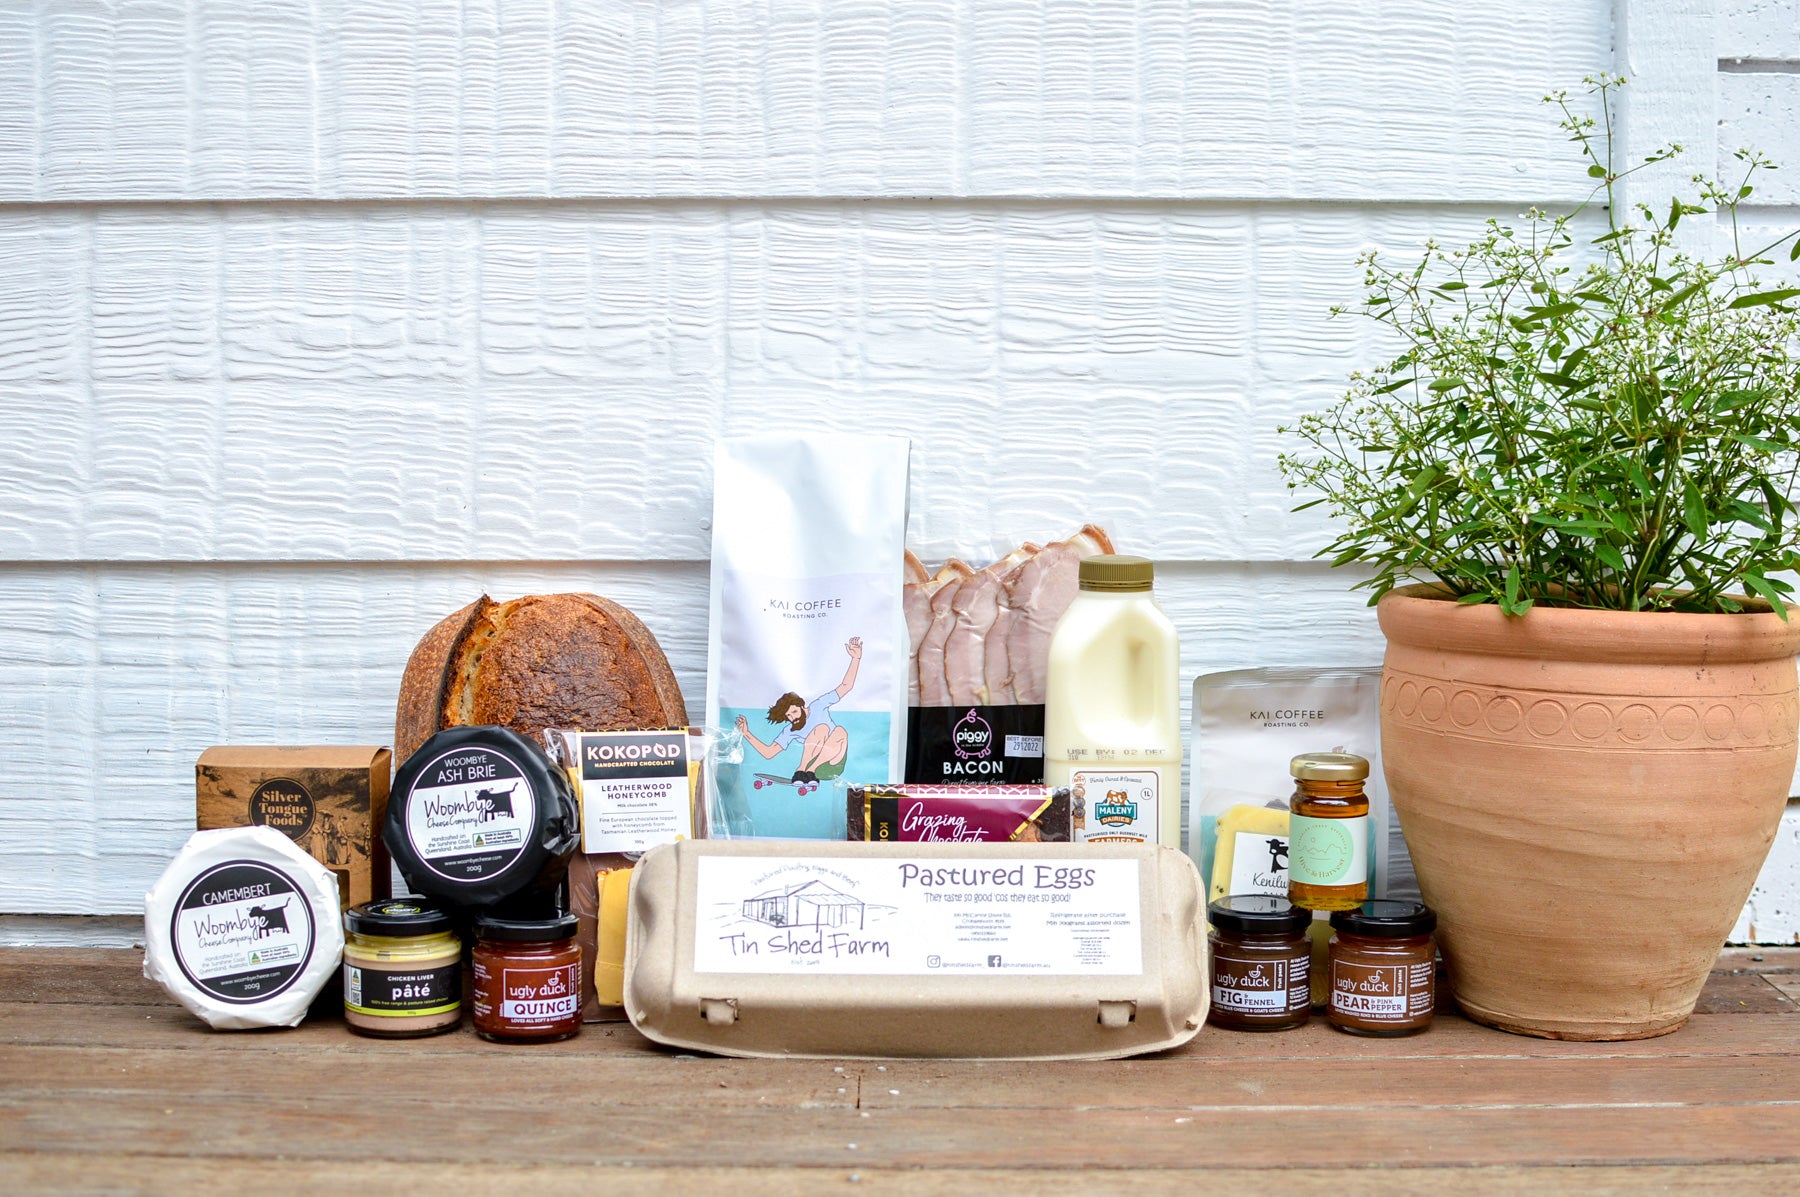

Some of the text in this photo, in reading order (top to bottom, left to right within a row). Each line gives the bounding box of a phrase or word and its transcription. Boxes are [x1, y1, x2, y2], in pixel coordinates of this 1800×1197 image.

[770, 599, 841, 611] KAI COFFEE
[1250, 710, 1324, 719] KAI COFFEE
[957, 728, 989, 743] piggy
[587, 743, 680, 760] KOKOPOD
[445, 755, 487, 767] WOOMBYE
[943, 761, 1003, 774] BACON
[437, 764, 496, 783] ASH BRIE
[601, 783, 672, 792] LEATHERWOOD
[262, 790, 302, 802] Silver
[259, 803, 308, 817] Tongue
[424, 790, 495, 823] Woombye
[265, 814, 304, 826] Foods
[902, 802, 967, 837] Grazing
[898, 864, 1096, 890] Pastured Eggs
[202, 883, 271, 905] CAMEMBERT
[924, 892, 942, 903] They
[944, 894, 962, 902] taste
[964, 894, 972, 902] so
[974, 892, 992, 903] good
[1010, 893, 1026, 903] they
[1027, 894, 1040, 902] eat
[1041, 894, 1050, 902] so
[1051, 893, 1071, 903] good!
[194, 908, 269, 941] Woombye
[719, 930, 890, 957] Tin Shed Farm
[1216, 974, 1270, 987] ugly duck
[1337, 978, 1389, 992] ugly duck
[392, 983, 430, 1000] pâté
[509, 982, 566, 999] ugly duck
[1220, 990, 1242, 1003] FIG
[514, 999, 572, 1015] QUINCE
[1336, 993, 1370, 1010] PEAR
